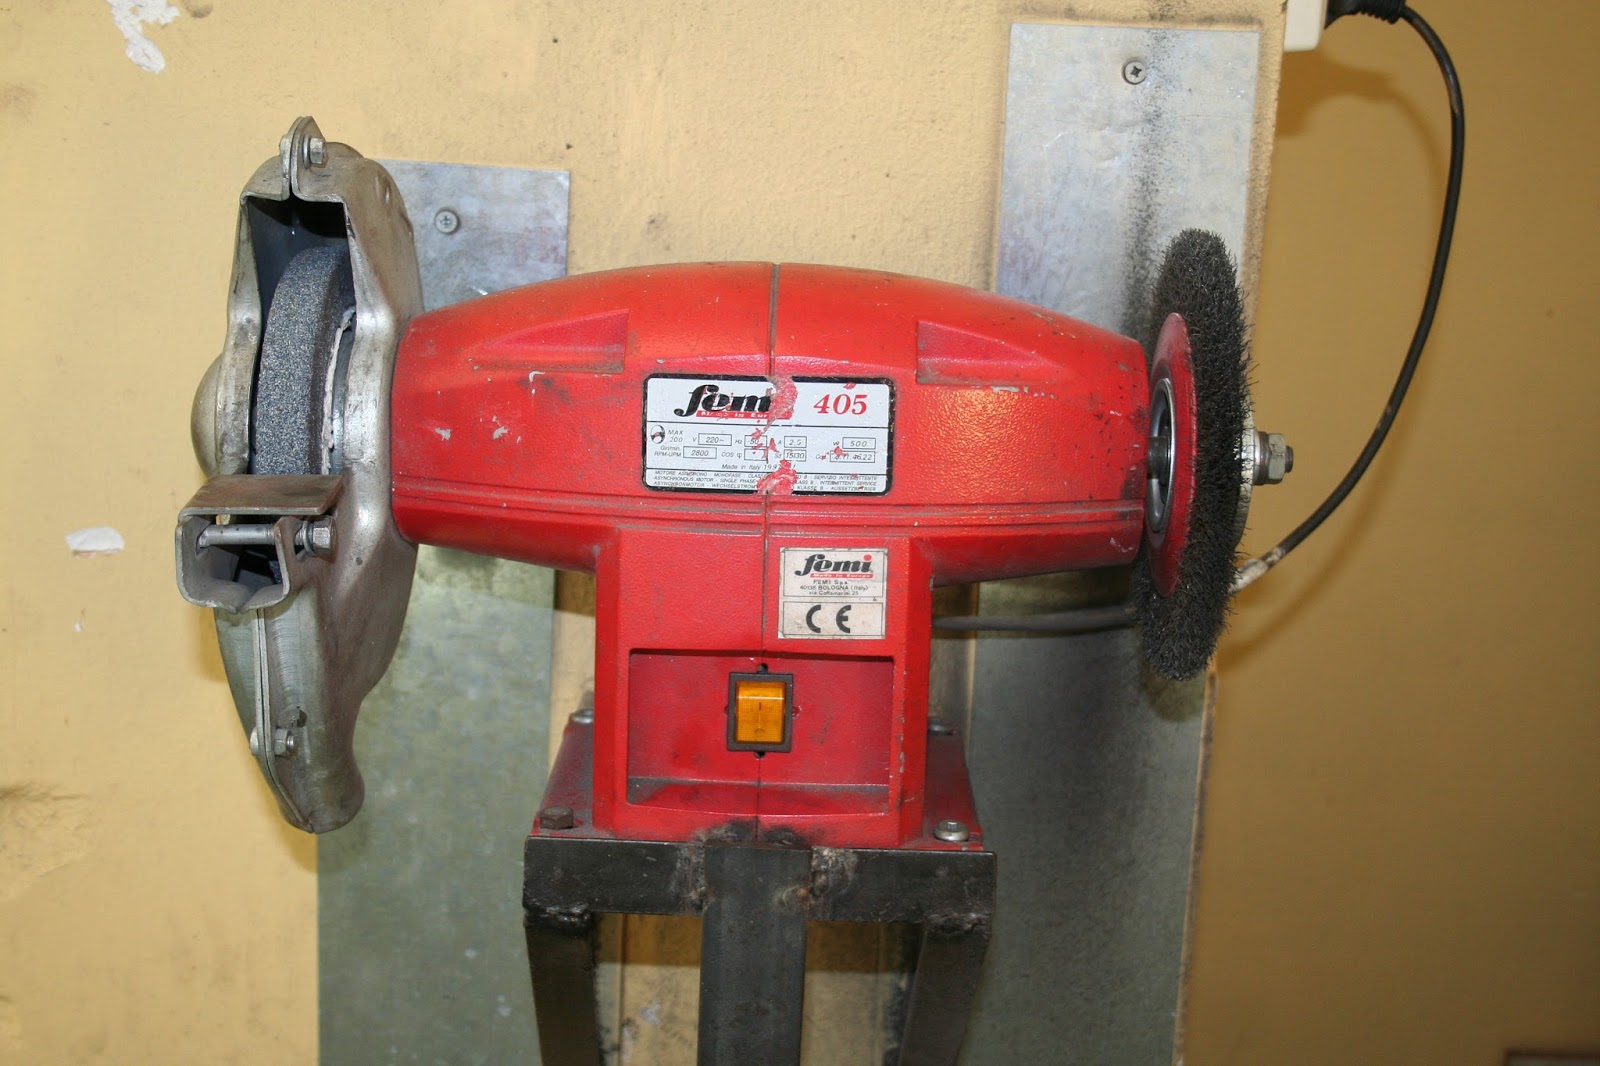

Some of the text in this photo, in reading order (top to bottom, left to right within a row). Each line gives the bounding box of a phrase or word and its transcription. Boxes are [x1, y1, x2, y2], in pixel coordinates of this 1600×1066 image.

[813, 393, 868, 415] 405
[849, 440, 868, 448] 500
[690, 449, 710, 457] 2800
[748, 463, 761, 472] Italy
[794, 553, 873, 576] femi
